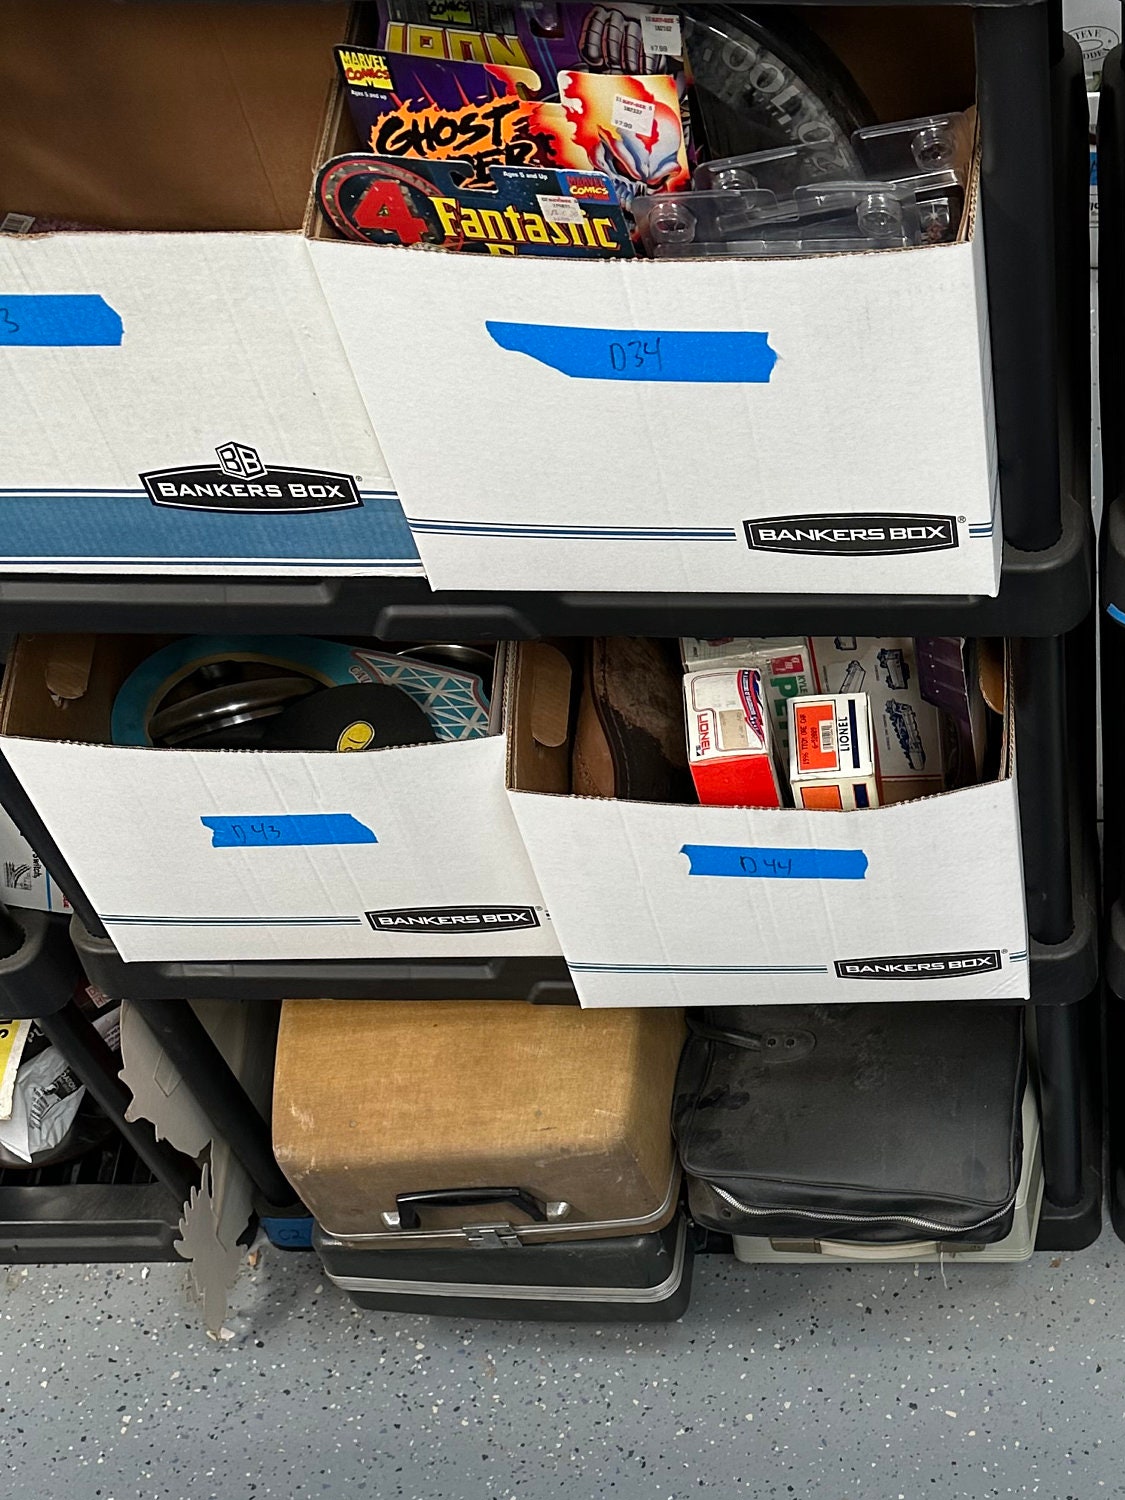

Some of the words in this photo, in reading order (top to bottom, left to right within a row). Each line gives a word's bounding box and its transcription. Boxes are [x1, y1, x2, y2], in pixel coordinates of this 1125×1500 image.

[340, 50, 386, 70] MARVEL
[345, 67, 391, 81] COMICS
[376, 100, 520, 157] GHOST
[503, 170, 519, 179] Ages
[526, 172, 538, 180] and
[566, 175, 606, 187] MARVEL
[569, 185, 609, 195] COMICS
[428, 195, 618, 249] Fantastic
[609, 337, 663, 373] D34
[157, 482, 283, 499] BANKERS
[289, 483, 347, 500] BOX
[758, 525, 886, 543] BANKERS
[889, 523, 947, 541] BOX
[797, 674, 809, 694] KYLE
[696, 713, 711, 756] LIONEL
[838, 716, 851, 752] LIONEL
[739, 855, 793, 876] D44
[377, 913, 480, 928] BANKERS
[481, 912, 530, 926] BOX
[845, 961, 945, 975] BANKERS
[948, 955, 993, 971] BOX
